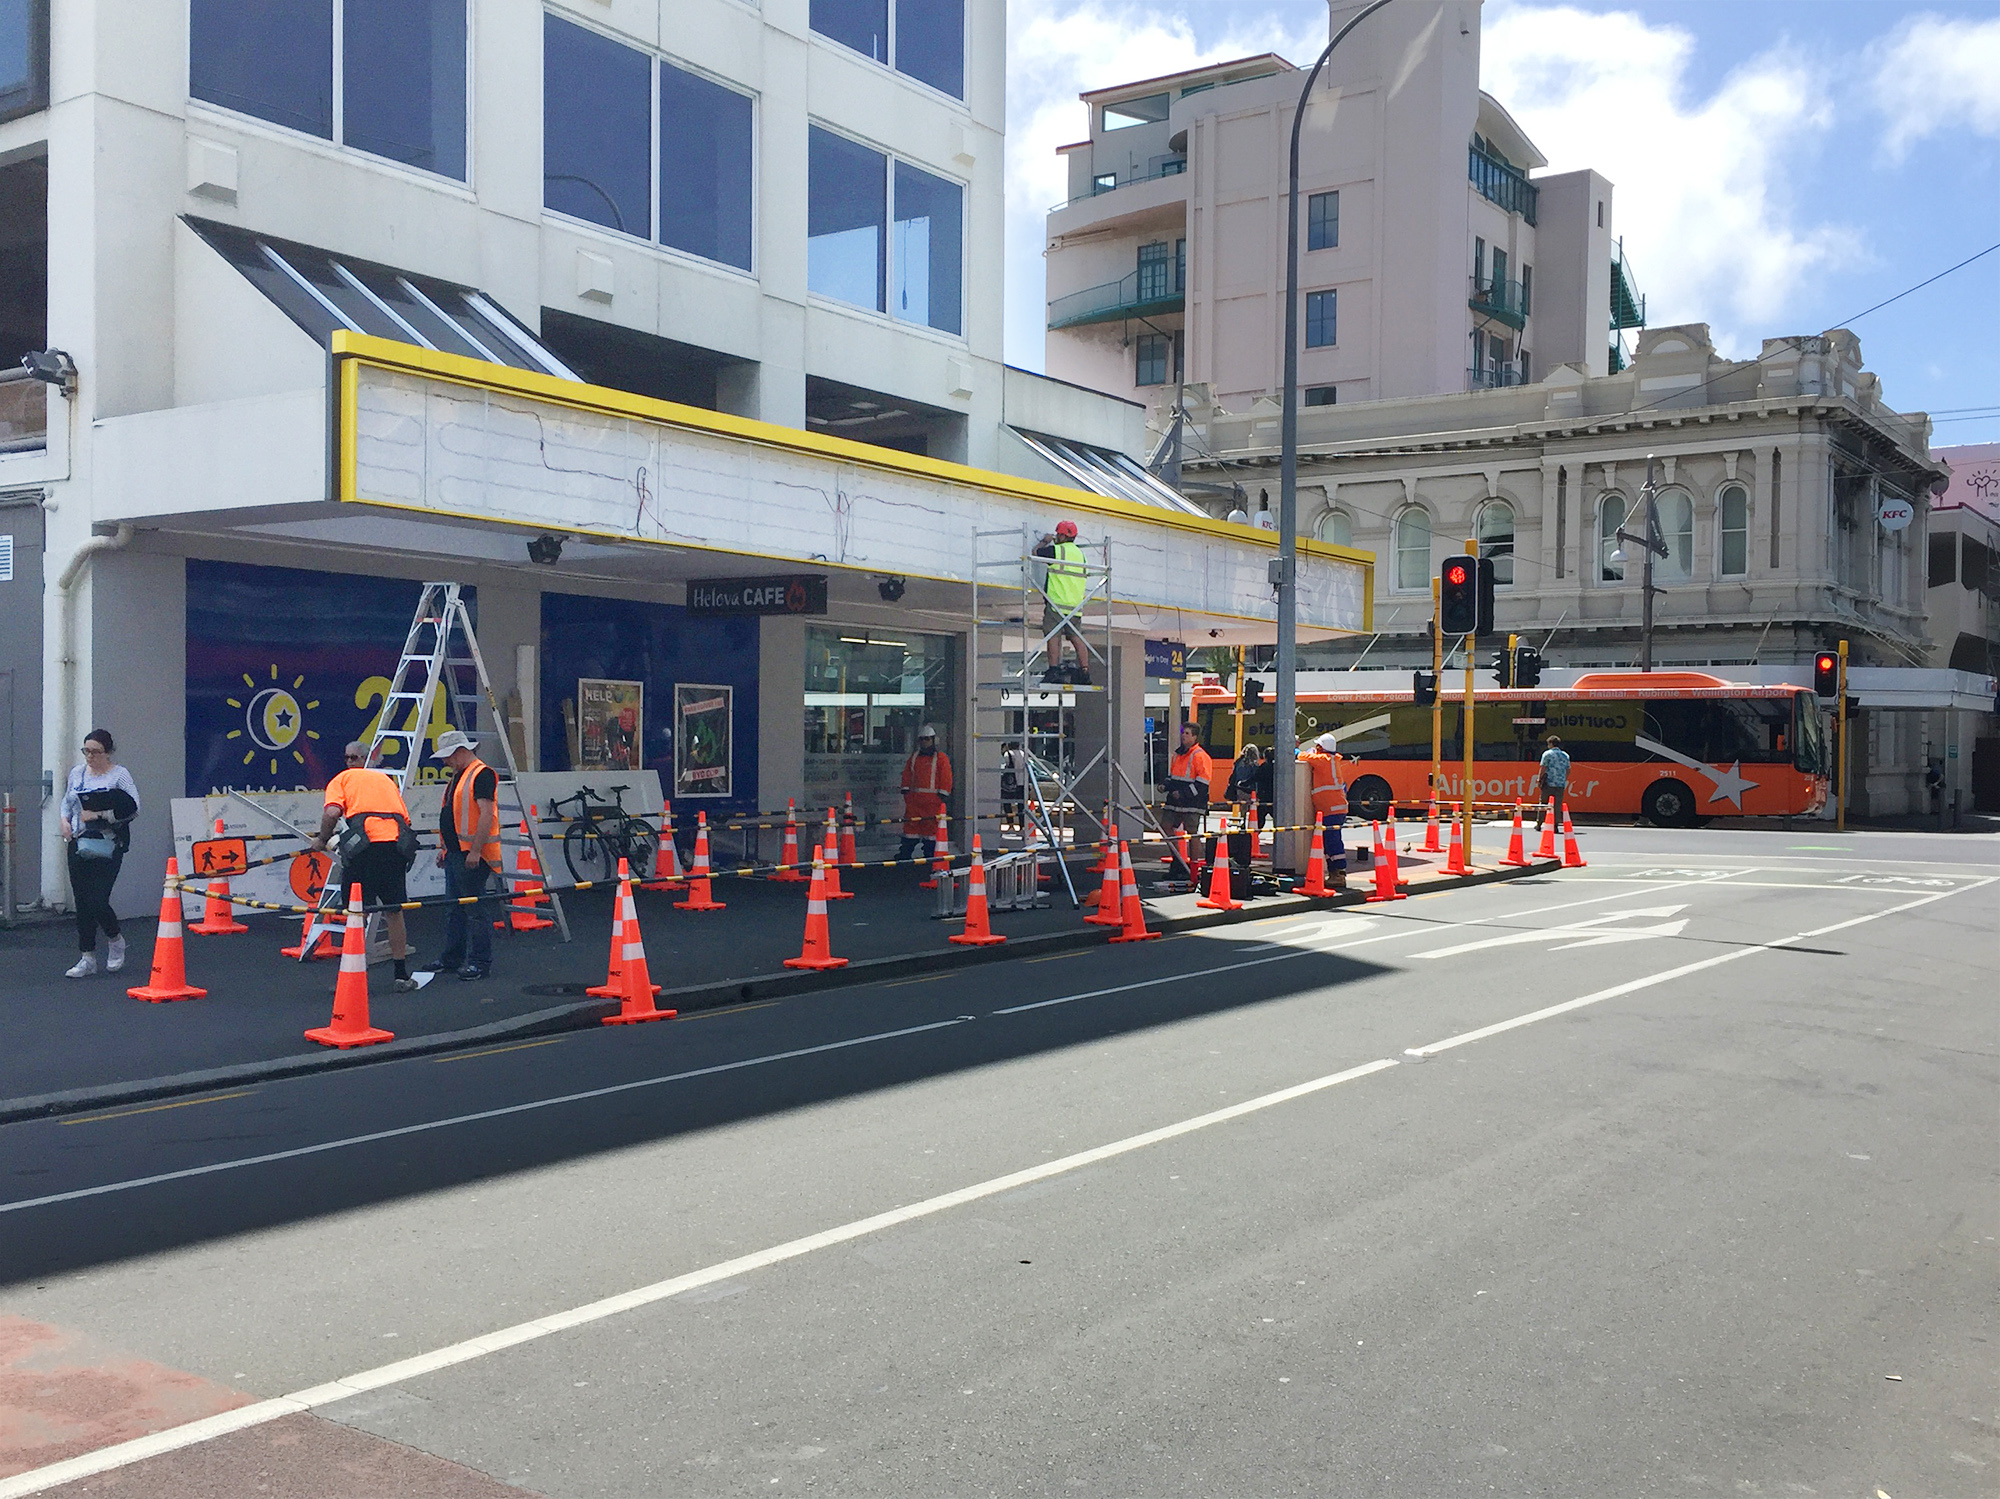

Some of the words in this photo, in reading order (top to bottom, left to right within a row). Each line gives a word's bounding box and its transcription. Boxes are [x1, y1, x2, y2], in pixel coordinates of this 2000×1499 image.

[1883, 510, 1907, 519] KFC
[694, 587, 740, 608] Helova
[743, 586, 785, 606] CAFE
[1171, 650, 1183, 666] 24
[1500, 690, 1549, 701] Courtenay
[1691, 688, 1748, 699] Wellington
[1750, 688, 1788, 698] Airport
[355, 676, 456, 755] 24
